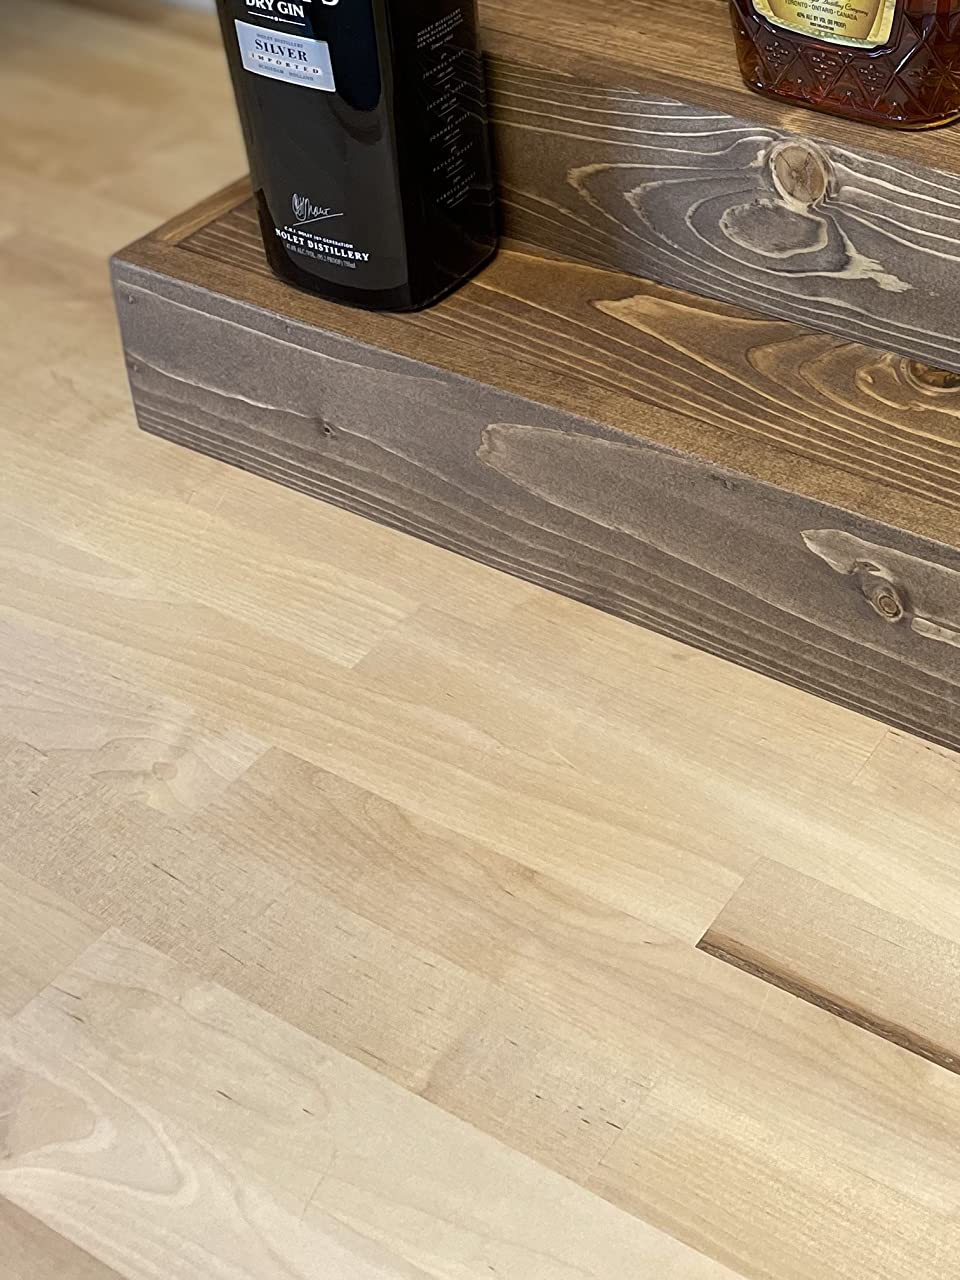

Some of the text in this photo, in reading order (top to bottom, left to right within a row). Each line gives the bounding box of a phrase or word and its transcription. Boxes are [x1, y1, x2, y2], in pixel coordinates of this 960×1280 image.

[277, 3, 304, 18] GIN
[255, 39, 308, 62] SILVER
[251, 52, 319, 74] IMPORTED
[275, 227, 304, 245] NOLET
[307, 239, 370, 261] DISTILLERY
